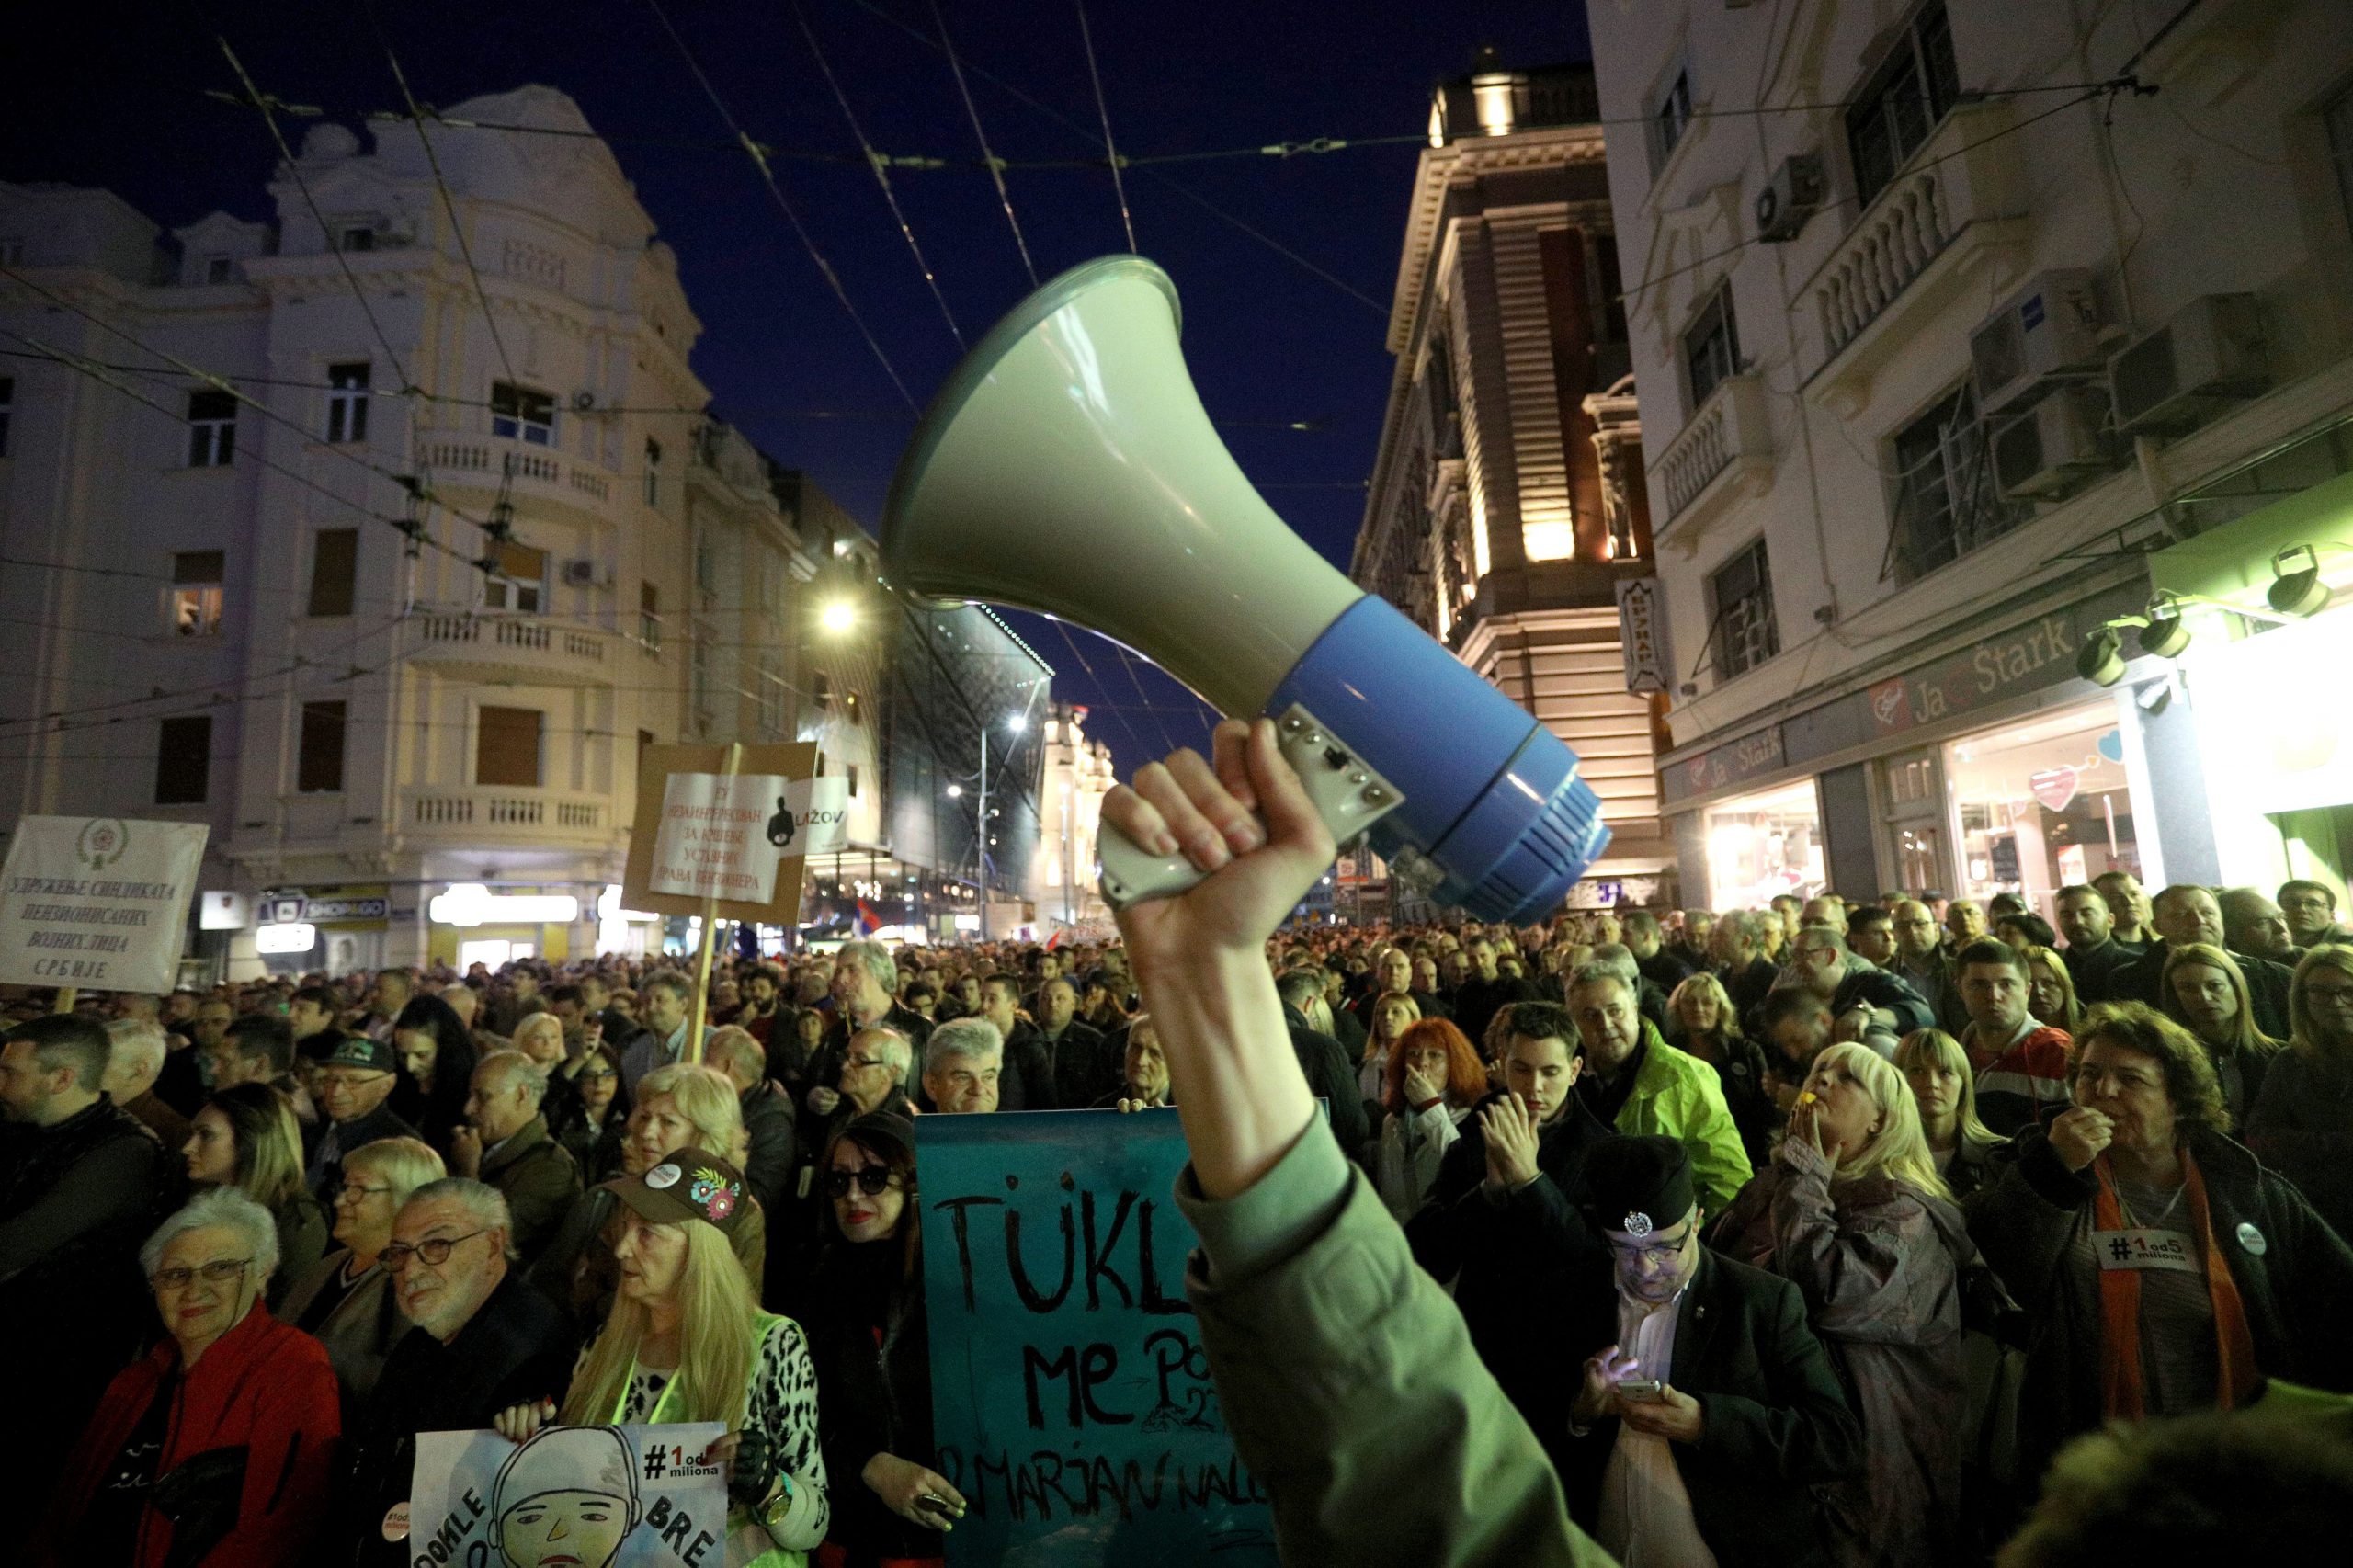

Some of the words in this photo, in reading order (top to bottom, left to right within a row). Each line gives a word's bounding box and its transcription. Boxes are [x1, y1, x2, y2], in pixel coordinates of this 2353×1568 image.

[1916, 681, 1947, 722] Ja
[795, 809, 844, 827] LAŽOV
[34, 958, 108, 979] СРБИЈЕ
[2137, 1250, 2186, 1262] miliona
[670, 1466, 719, 1478] miliona
[645, 1495, 716, 1568] BRE
